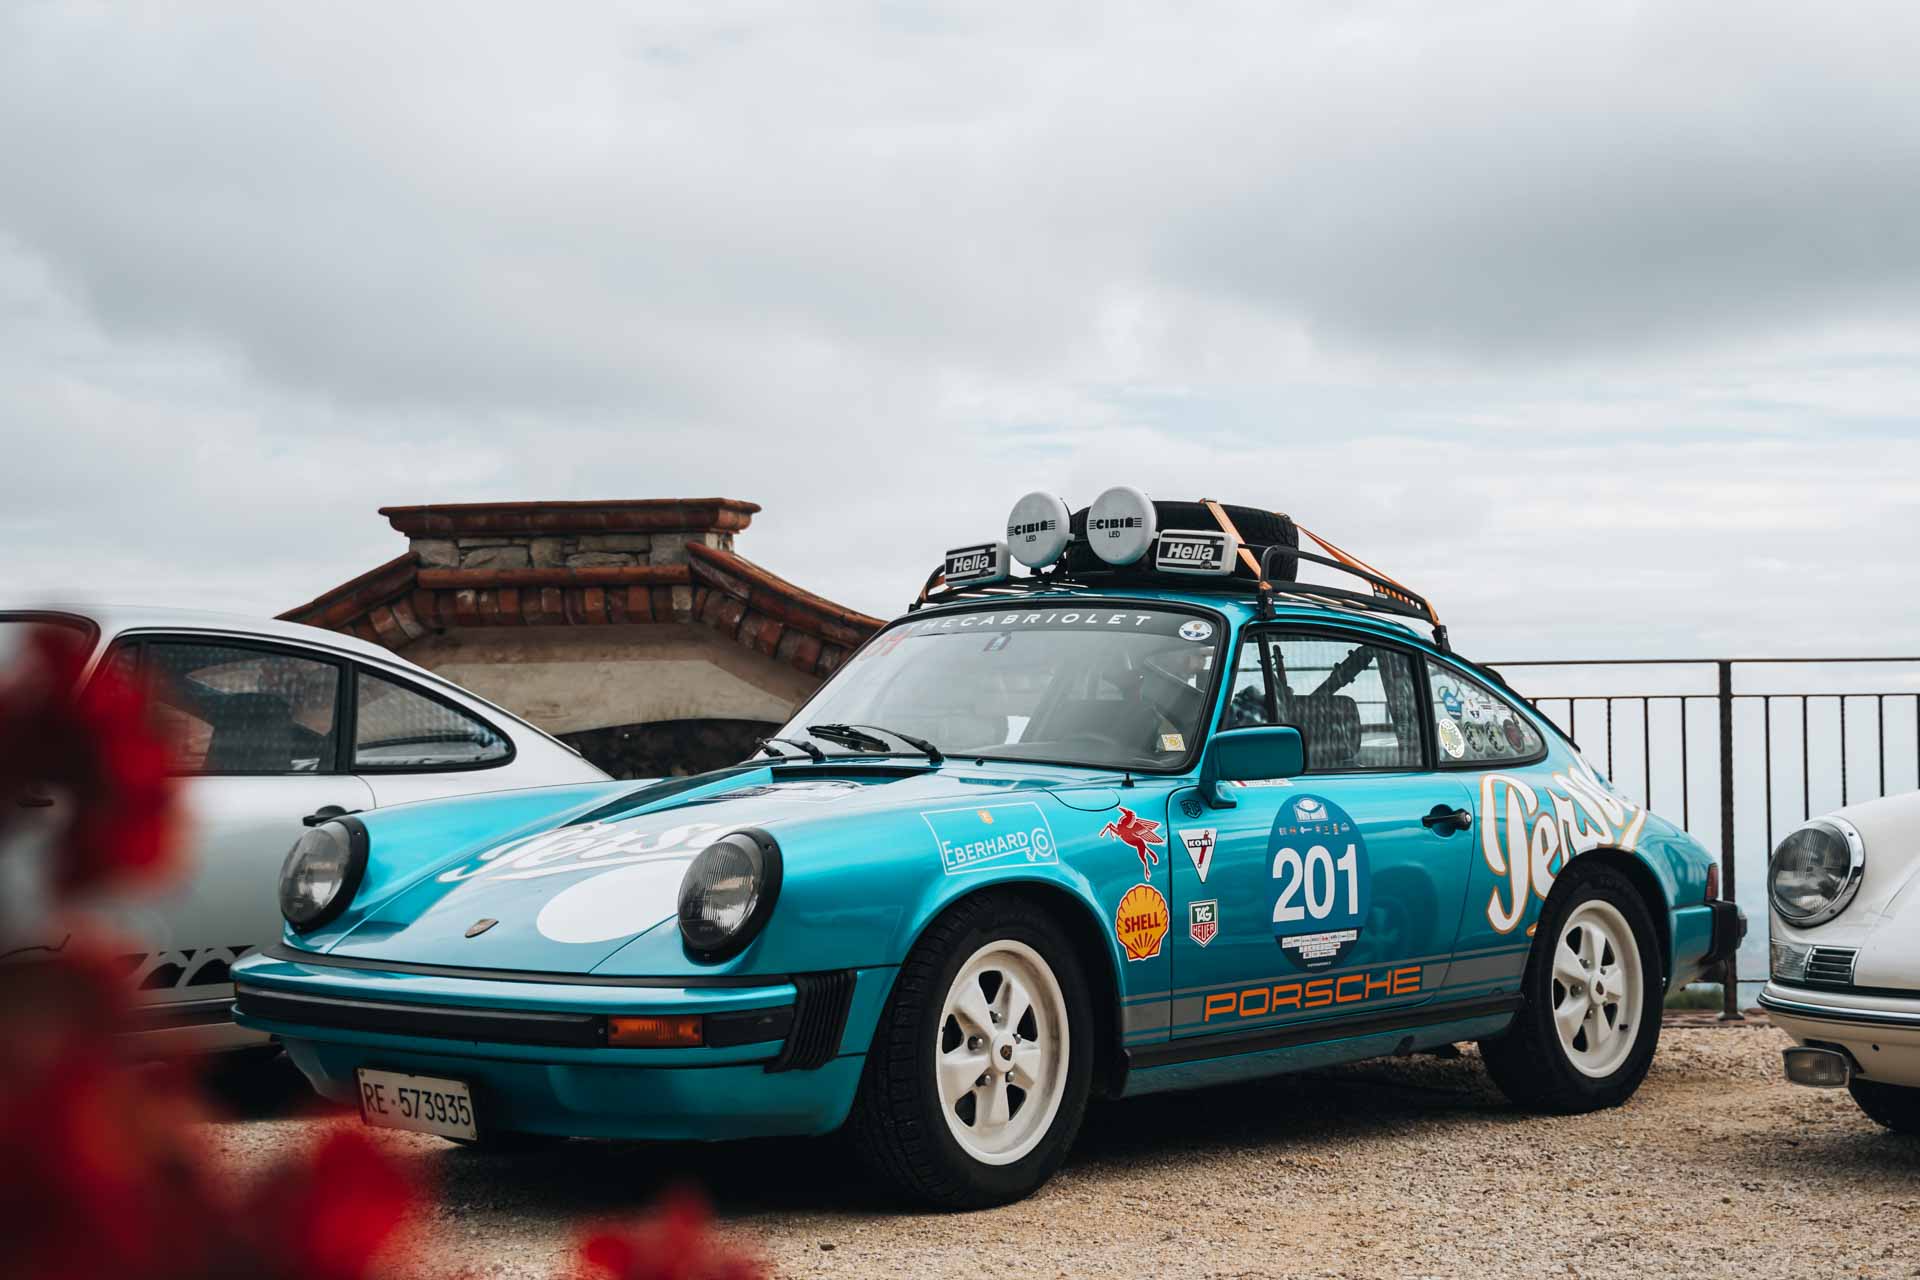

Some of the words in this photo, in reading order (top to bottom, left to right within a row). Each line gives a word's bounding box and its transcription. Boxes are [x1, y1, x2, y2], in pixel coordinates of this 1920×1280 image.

[1025, 534, 1037, 543] LED
[1108, 530, 1121, 539] LED
[1166, 542, 1215, 561] Hella
[952, 554, 990, 574] Hella
[942, 831, 1029, 867] EBERHARD
[1187, 838, 1212, 849] KONI
[1272, 843, 1359, 923] 201
[1124, 911, 1162, 935] SHELL
[1195, 905, 1213, 923] TAG
[1192, 923, 1216, 942] HEUER
[1203, 965, 1422, 1023] PORSCHE
